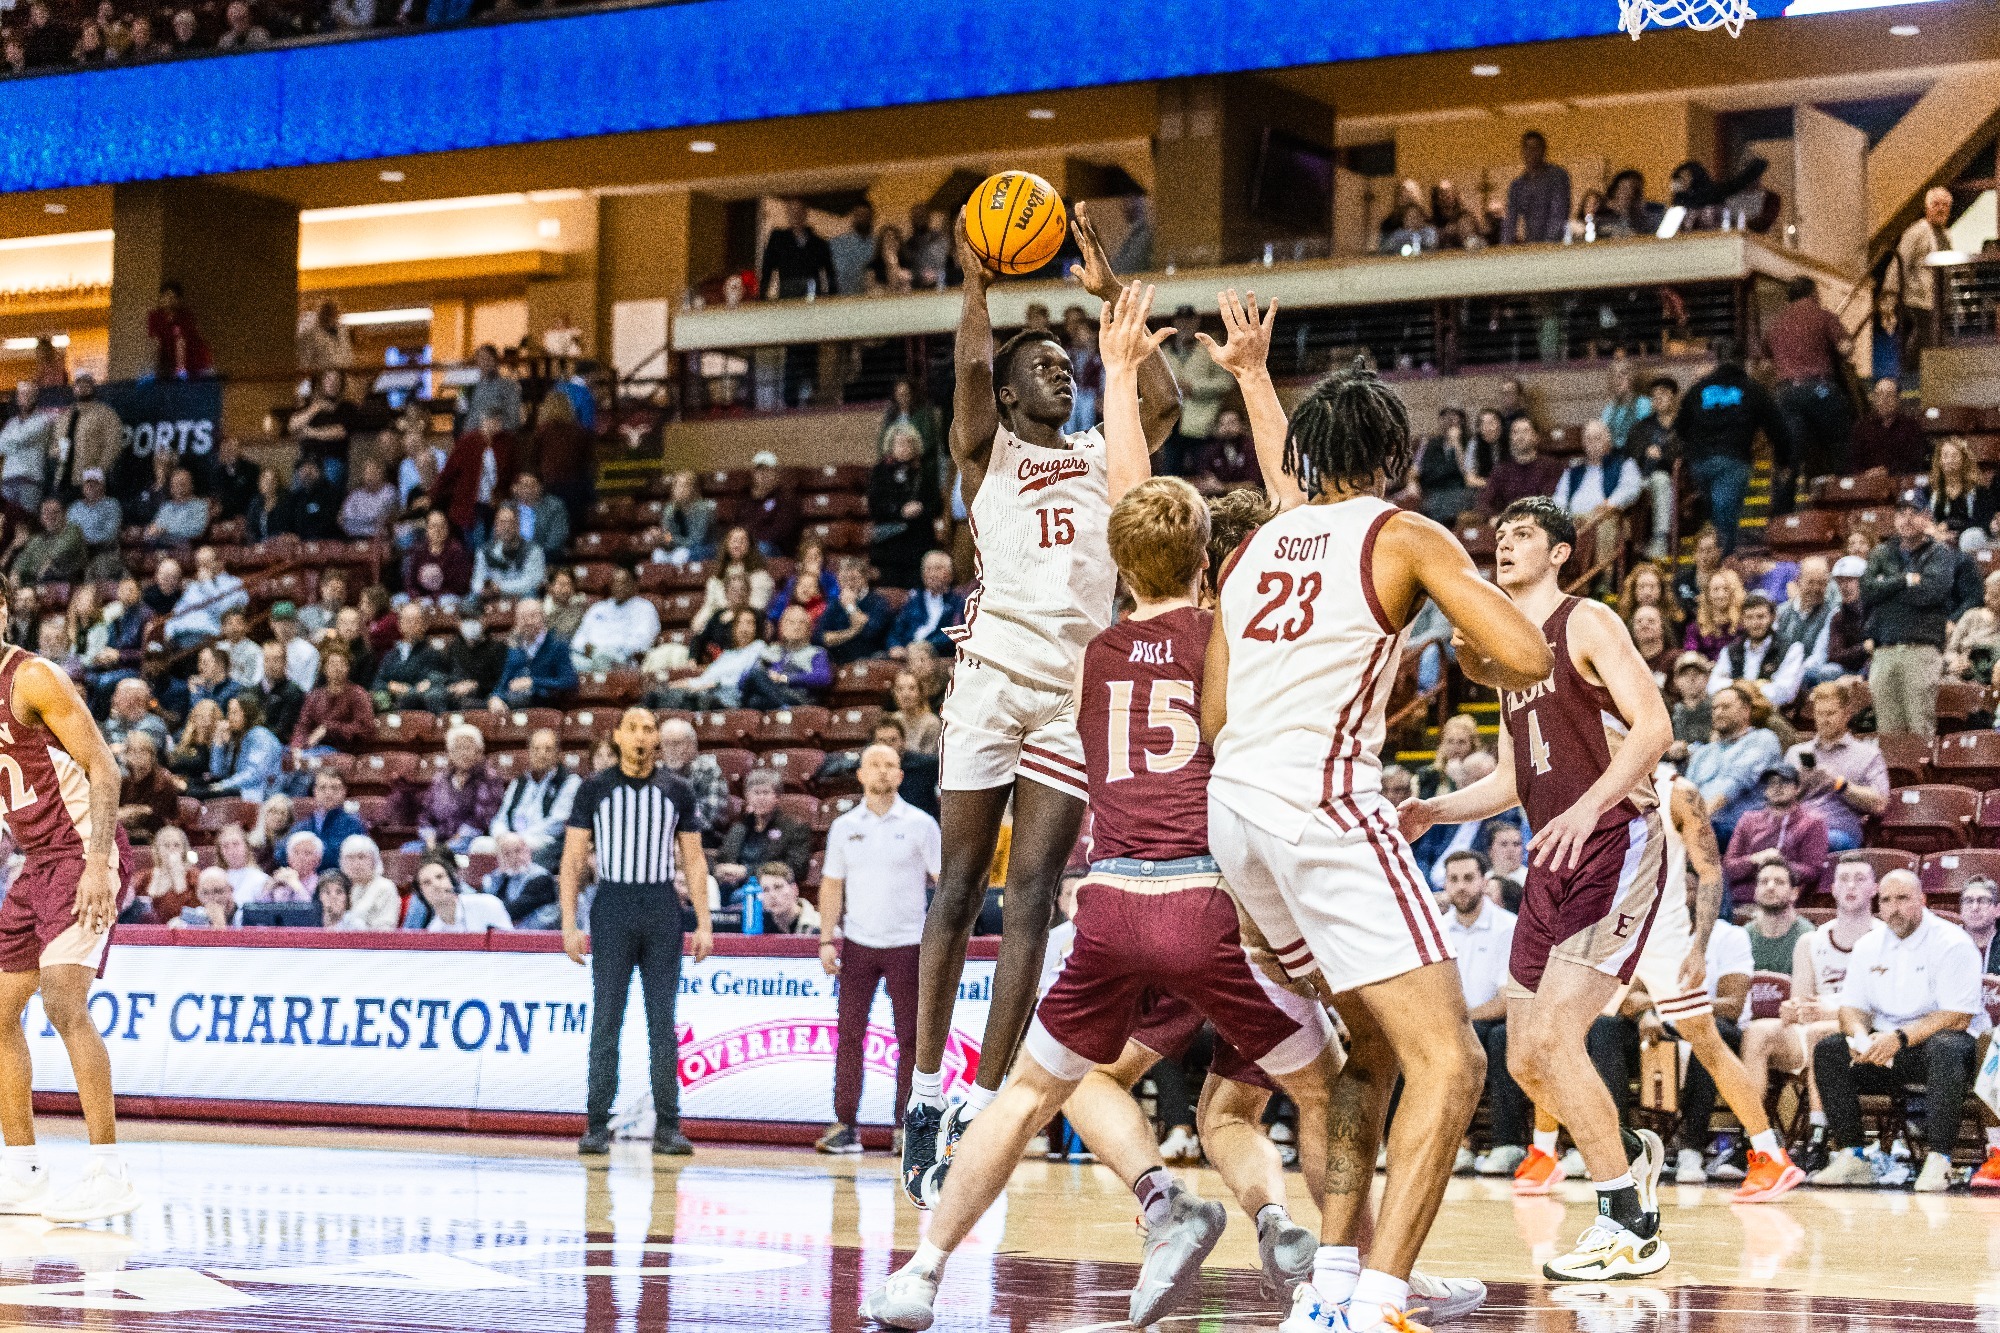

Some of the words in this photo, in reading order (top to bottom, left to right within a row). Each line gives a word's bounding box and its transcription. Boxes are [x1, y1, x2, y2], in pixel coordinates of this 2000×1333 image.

[120, 419, 213, 457] PORTS
[1018, 457, 1090, 486] Cougars
[1036, 508, 1076, 548] 15
[1274, 533, 1330, 561] SCOTT
[1242, 571, 1322, 643] 23
[1128, 640, 1174, 664] HULL
[1105, 679, 1200, 783] 15
[1527, 709, 1552, 775] 4
[0, 753, 38, 815] 2
[1613, 913, 1635, 939] E
[711, 970, 820, 997] Genuine.
[87, 991, 157, 1040] OF
[683, 1026, 838, 1081] OVERHEA
